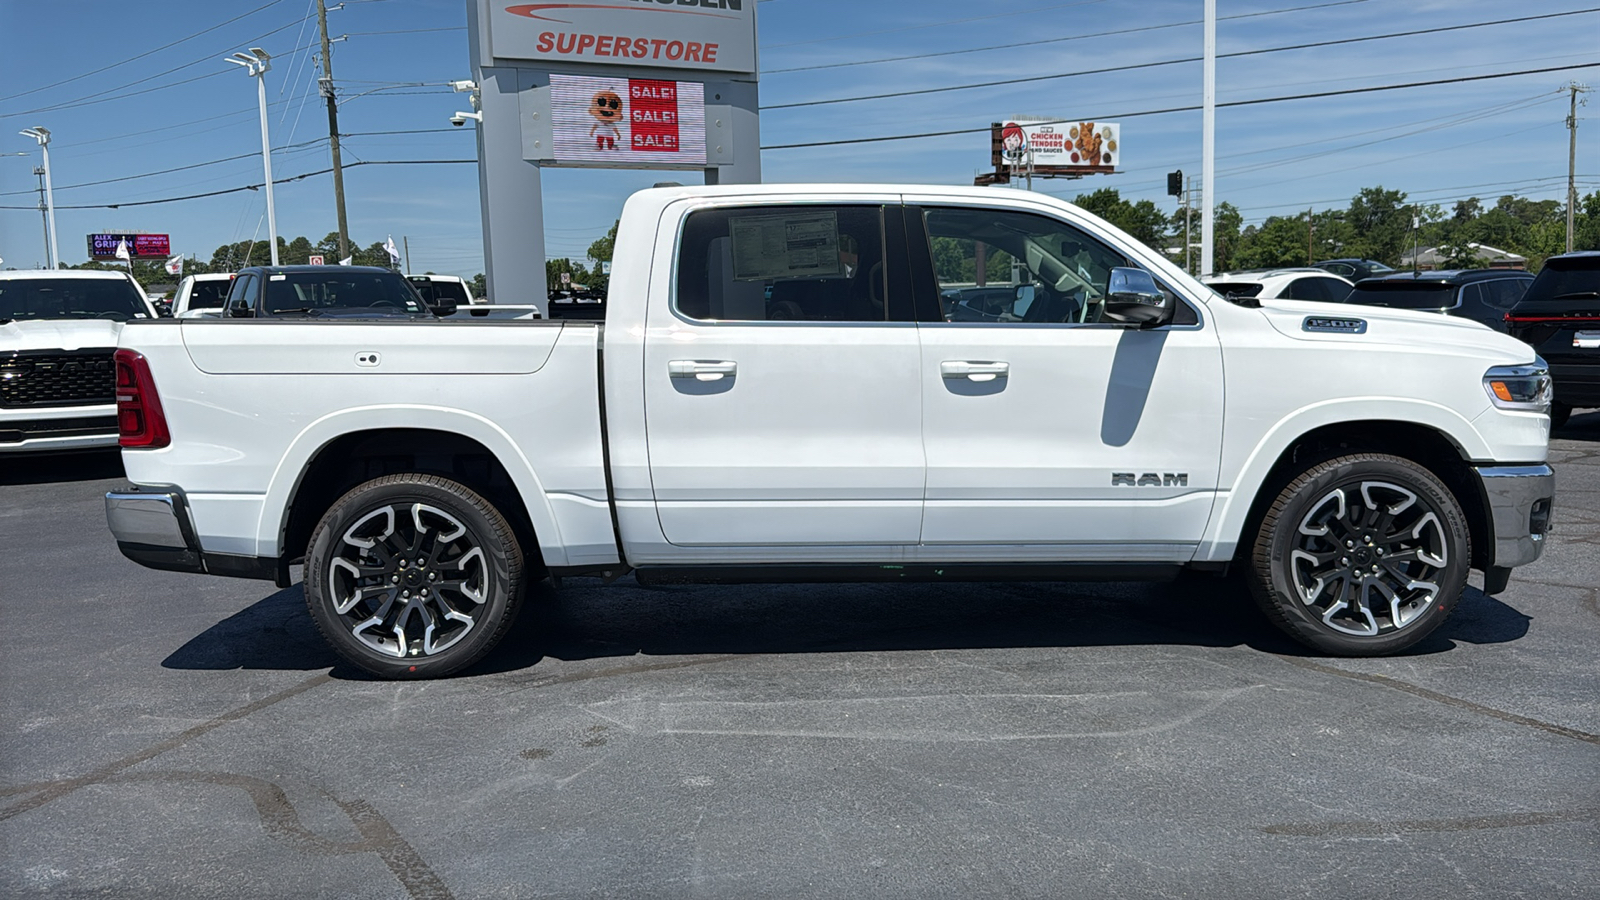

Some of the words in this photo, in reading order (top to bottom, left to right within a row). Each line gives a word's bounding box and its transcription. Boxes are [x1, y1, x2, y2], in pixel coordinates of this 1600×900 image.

[536, 31, 719, 63] SUPERSTORE
[632, 86, 675, 100] SALE!
[632, 110, 676, 123] SALE!
[633, 134, 676, 147] SALE!
[95, 240, 132, 248] GRIFFN
[1308, 319, 1360, 329] 1500
[1111, 472, 1188, 486] RAM
[1393, 471, 1446, 505] ORPION
